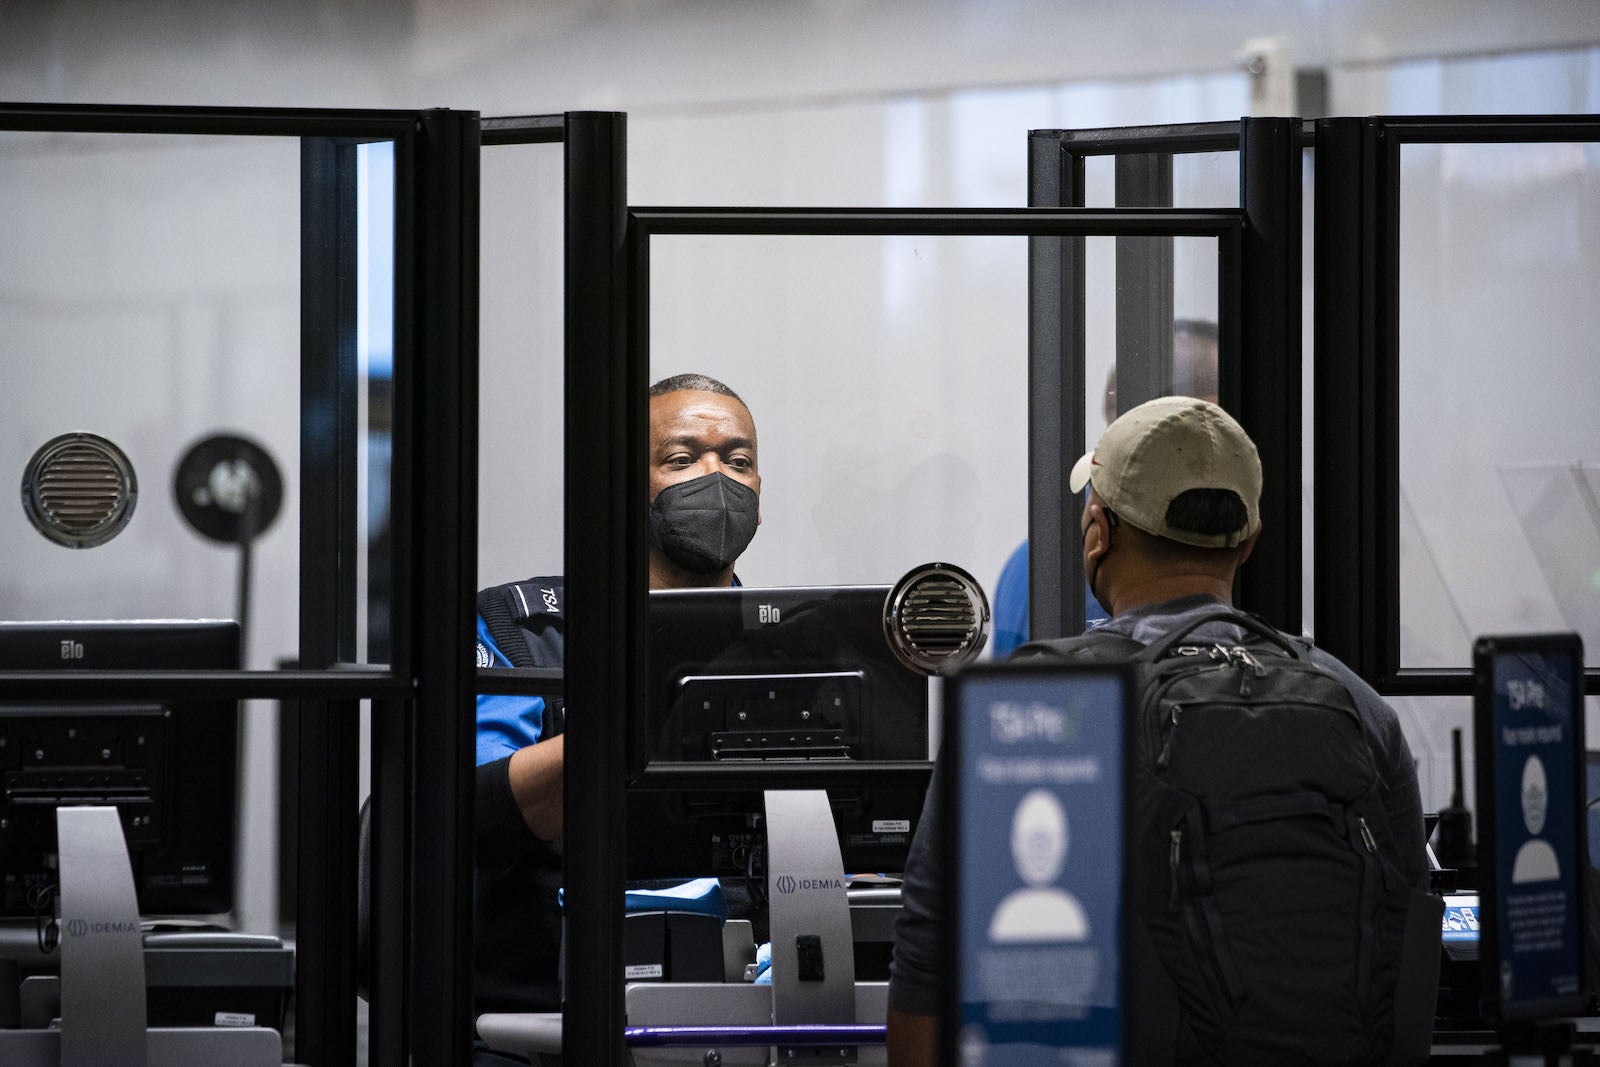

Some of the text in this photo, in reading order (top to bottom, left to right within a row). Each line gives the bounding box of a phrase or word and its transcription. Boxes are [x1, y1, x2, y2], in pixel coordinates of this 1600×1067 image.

[540, 587, 560, 613] TSA
[798, 879, 842, 890] IDEMIA
[91, 922, 137, 934] IDEMIA
